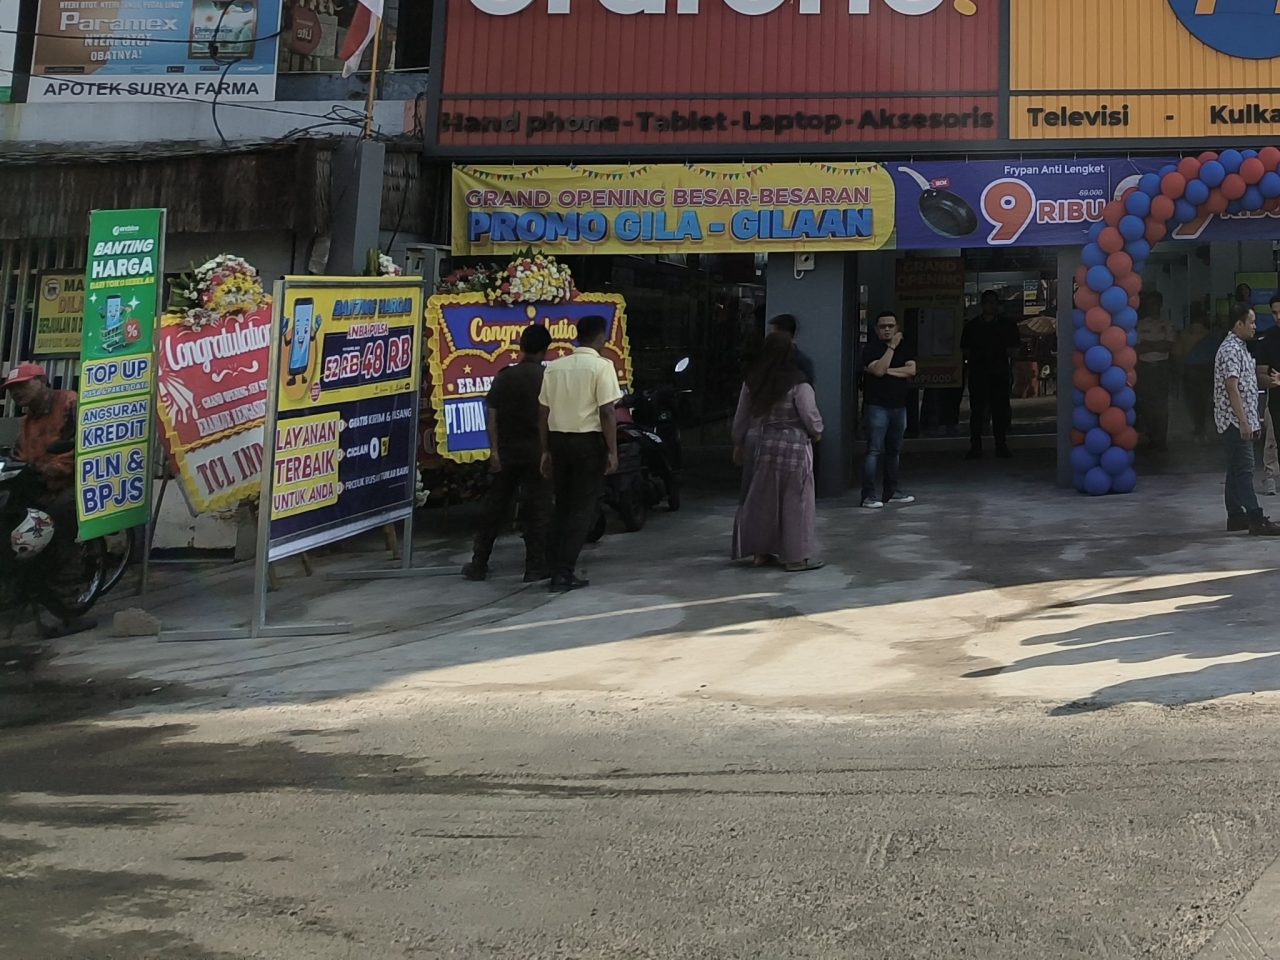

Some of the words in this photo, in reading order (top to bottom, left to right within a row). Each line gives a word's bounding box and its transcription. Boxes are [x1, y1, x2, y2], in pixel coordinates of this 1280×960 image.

[59, 11, 178, 31] Paramex
[90, 50, 142, 61] OBATNYA!
[43, 82, 123, 96] APOTEK
[127, 82, 189, 96] SURYA
[195, 82, 259, 96] FARMA
[440, 111, 520, 133] Hand
[526, 111, 620, 138] phone
[636, 110, 728, 132] Tablet
[742, 111, 841, 135] Laptop
[857, 106, 994, 129] Aksesoris
[1027, 107, 1129, 127] Televisi
[1004, 165, 1039, 176] Frypan
[1041, 165, 1062, 174] Anti
[1065, 164, 1105, 176] Lengket
[464, 189, 551, 208] GRAND
[558, 188, 666, 208] OPENING
[672, 186, 870, 207] BESAR-BESARAN
[980, 177, 1036, 245] 9
[1037, 199, 1105, 223] RIBU
[468, 210, 607, 242] PROMO
[614, 209, 702, 242] GILA
[731, 208, 874, 240] GILAAN
[93, 238, 154, 256] BANTING
[92, 256, 153, 279] HARGA
[85, 363, 118, 386] TOP
[121, 358, 148, 379] UP
[323, 355, 341, 382] 52
[340, 352, 360, 378] RB
[361, 340, 385, 379] 48
[386, 335, 412, 373] RB
[82, 400, 148, 424] ANGSURAN
[81, 418, 147, 448] KREDIT
[275, 420, 337, 452] LAYANAN
[81, 451, 122, 485] PLN
[126, 448, 144, 473] &
[196, 456, 235, 495] TCL
[274, 448, 335, 487] TERBAIK
[82, 475, 144, 515] BPJS
[273, 490, 306, 512] UNTUK
[307, 482, 334, 502] ANDA
